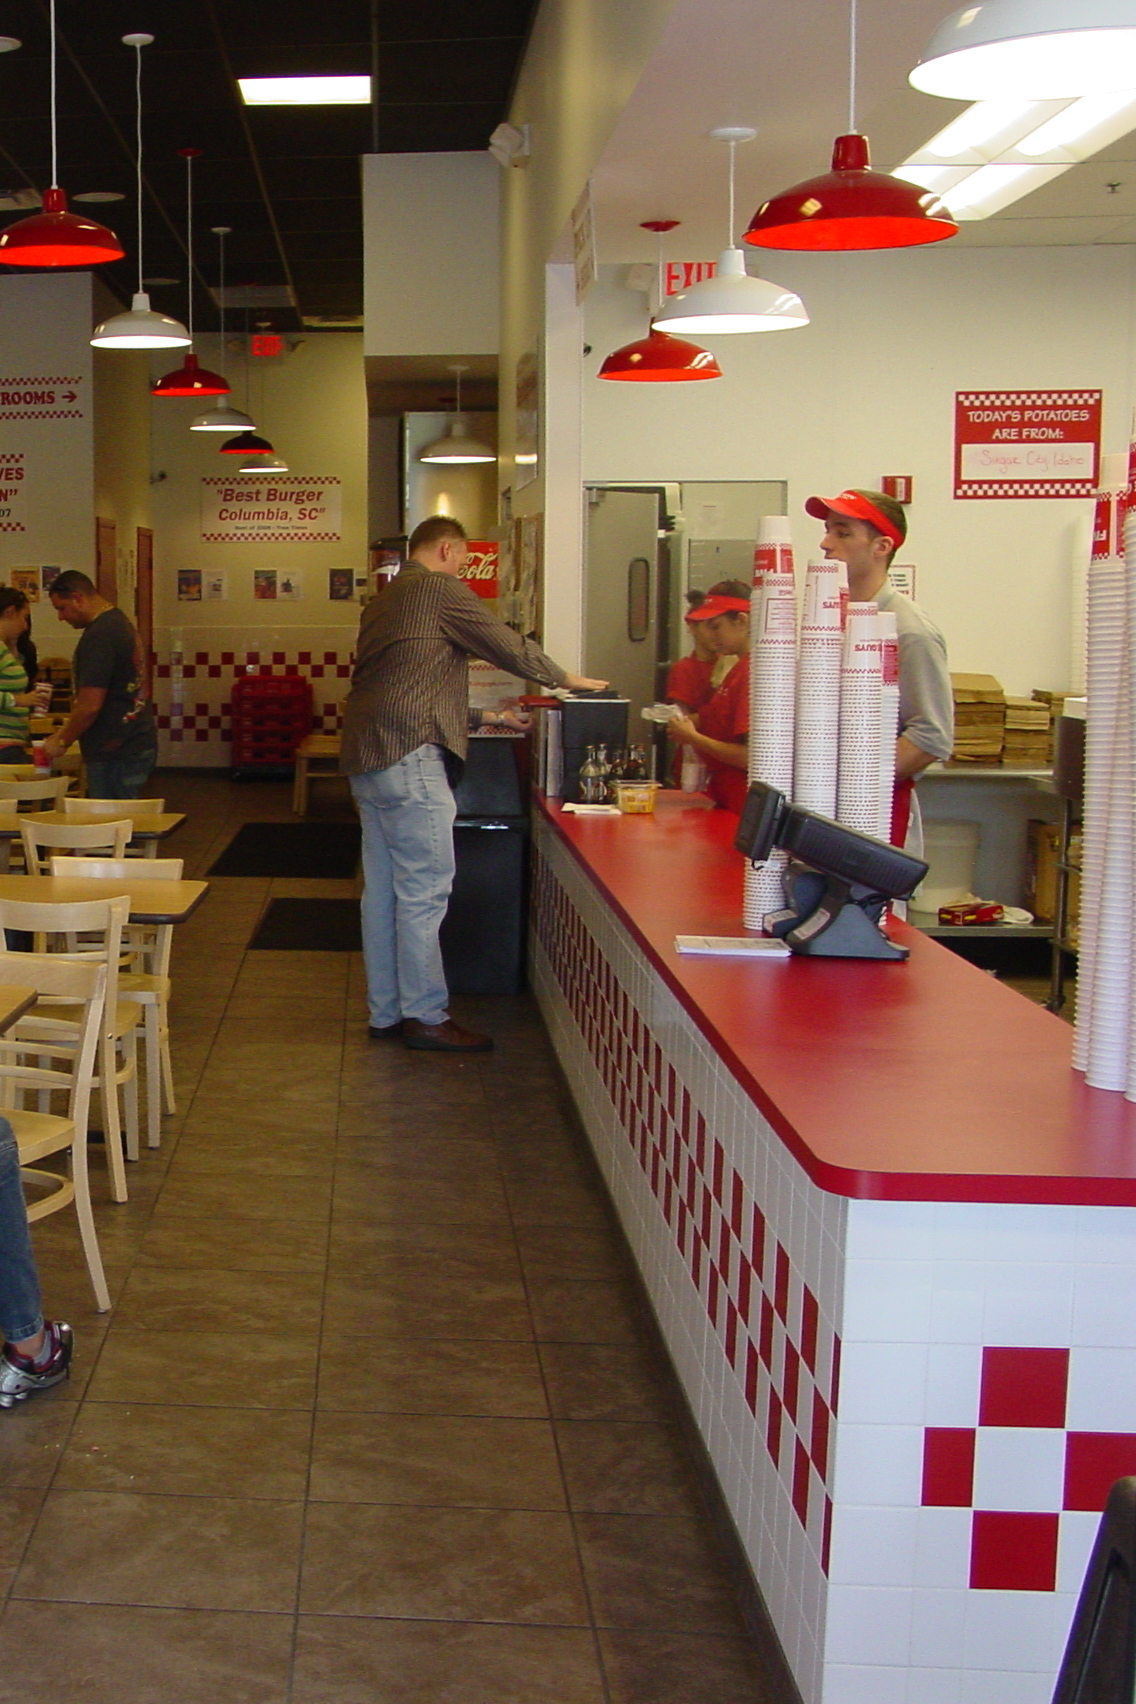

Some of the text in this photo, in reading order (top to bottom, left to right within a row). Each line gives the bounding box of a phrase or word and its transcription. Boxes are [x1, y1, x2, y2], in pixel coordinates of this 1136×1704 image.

[666, 262, 717, 296] EXIT
[967, 409, 1090, 422] TODAY'S POTATOES
[992, 427, 1065, 439] ARE FROM:
[265, 488, 324, 504] Burger
[218, 508, 293, 522] Columbia,
